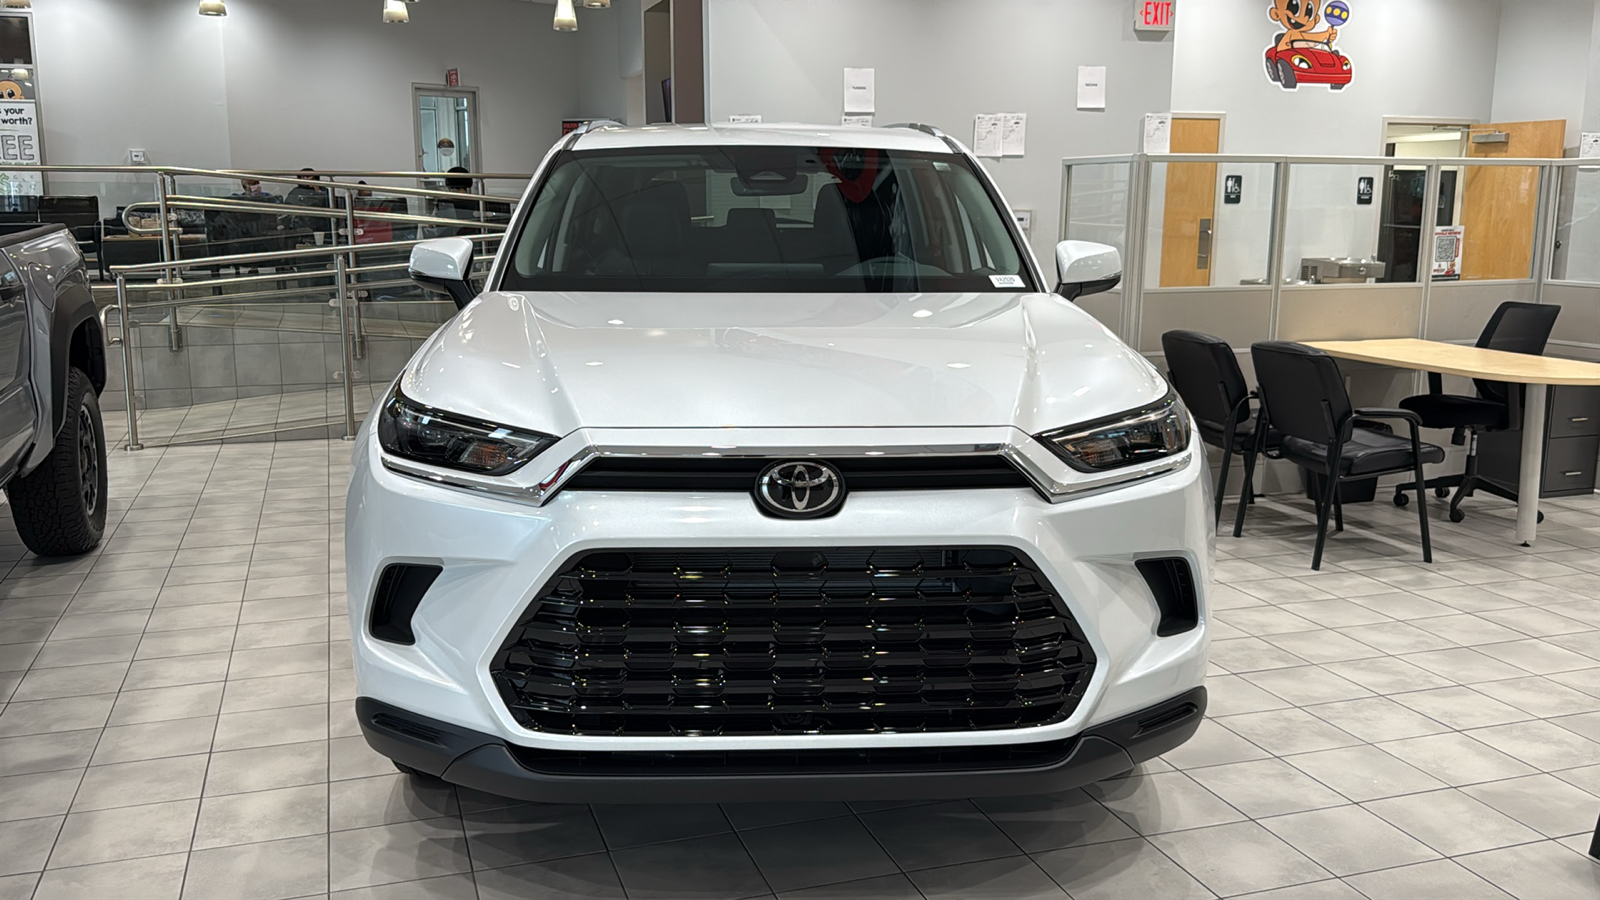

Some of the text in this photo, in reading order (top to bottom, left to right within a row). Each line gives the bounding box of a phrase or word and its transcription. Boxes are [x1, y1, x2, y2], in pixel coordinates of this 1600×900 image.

[1144, 1, 1171, 26] EXIT
[4, 108, 24, 116] your
[1, 117, 32, 125] worth?
[0, 135, 34, 160] EE
